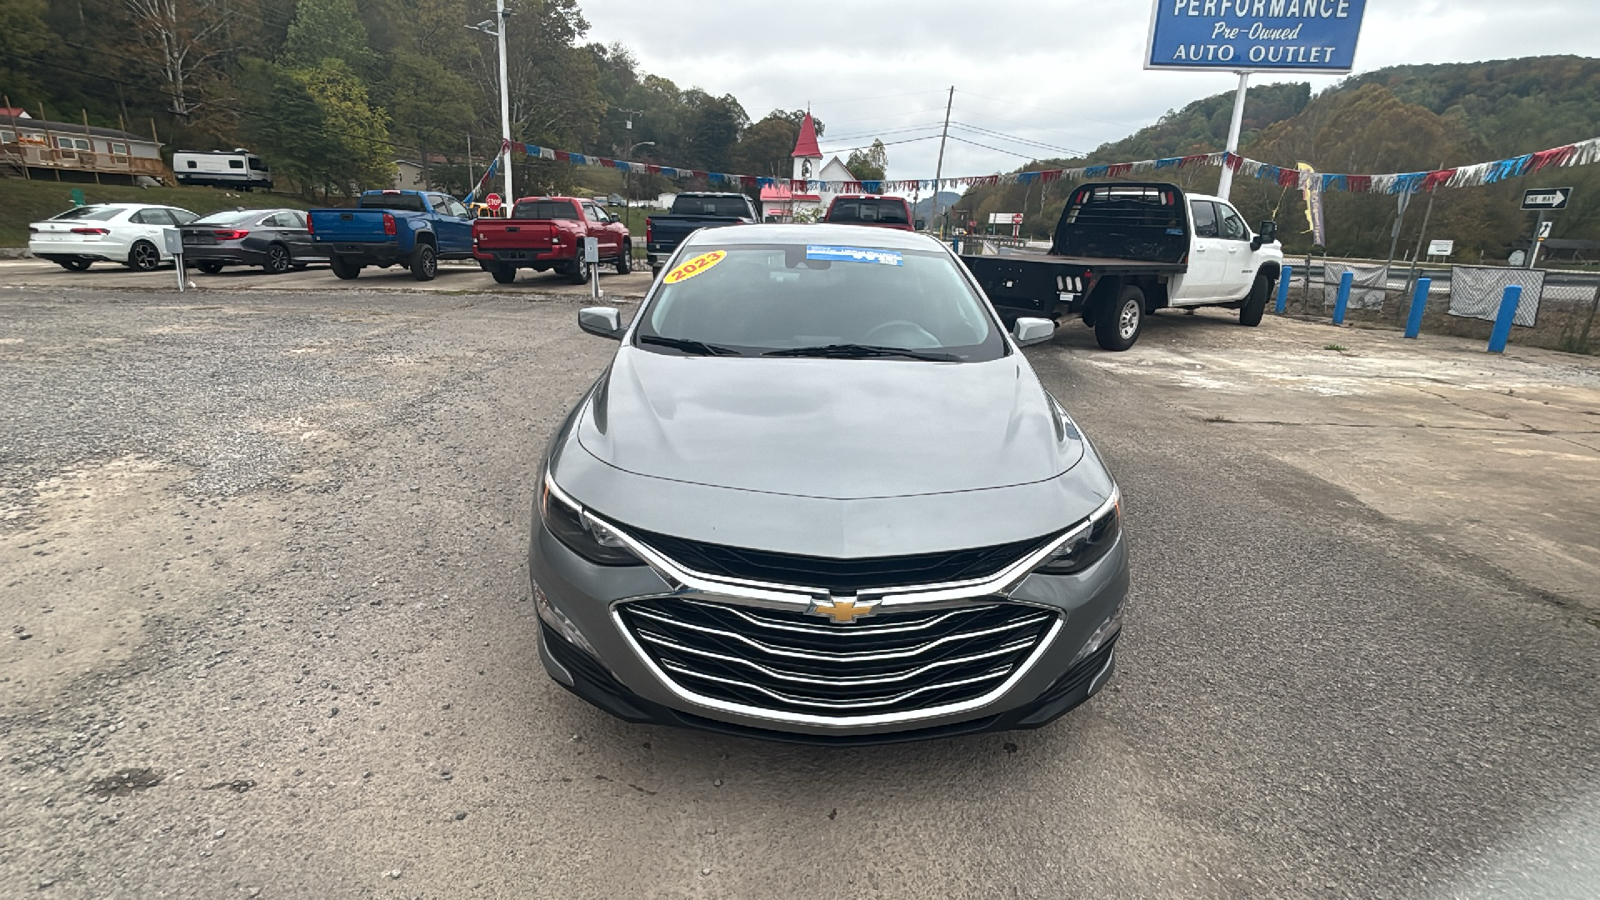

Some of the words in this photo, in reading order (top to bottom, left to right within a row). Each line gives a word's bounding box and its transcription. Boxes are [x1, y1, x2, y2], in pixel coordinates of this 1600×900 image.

[1174, 0, 1348, 18] PERFORMANCE
[1212, 22, 1303, 40] Pre-Owned
[1173, 44, 1235, 62] AUTO
[1248, 45, 1336, 63] OUTLET
[487, 198, 501, 206] STOP
[671, 252, 722, 281] 2023
